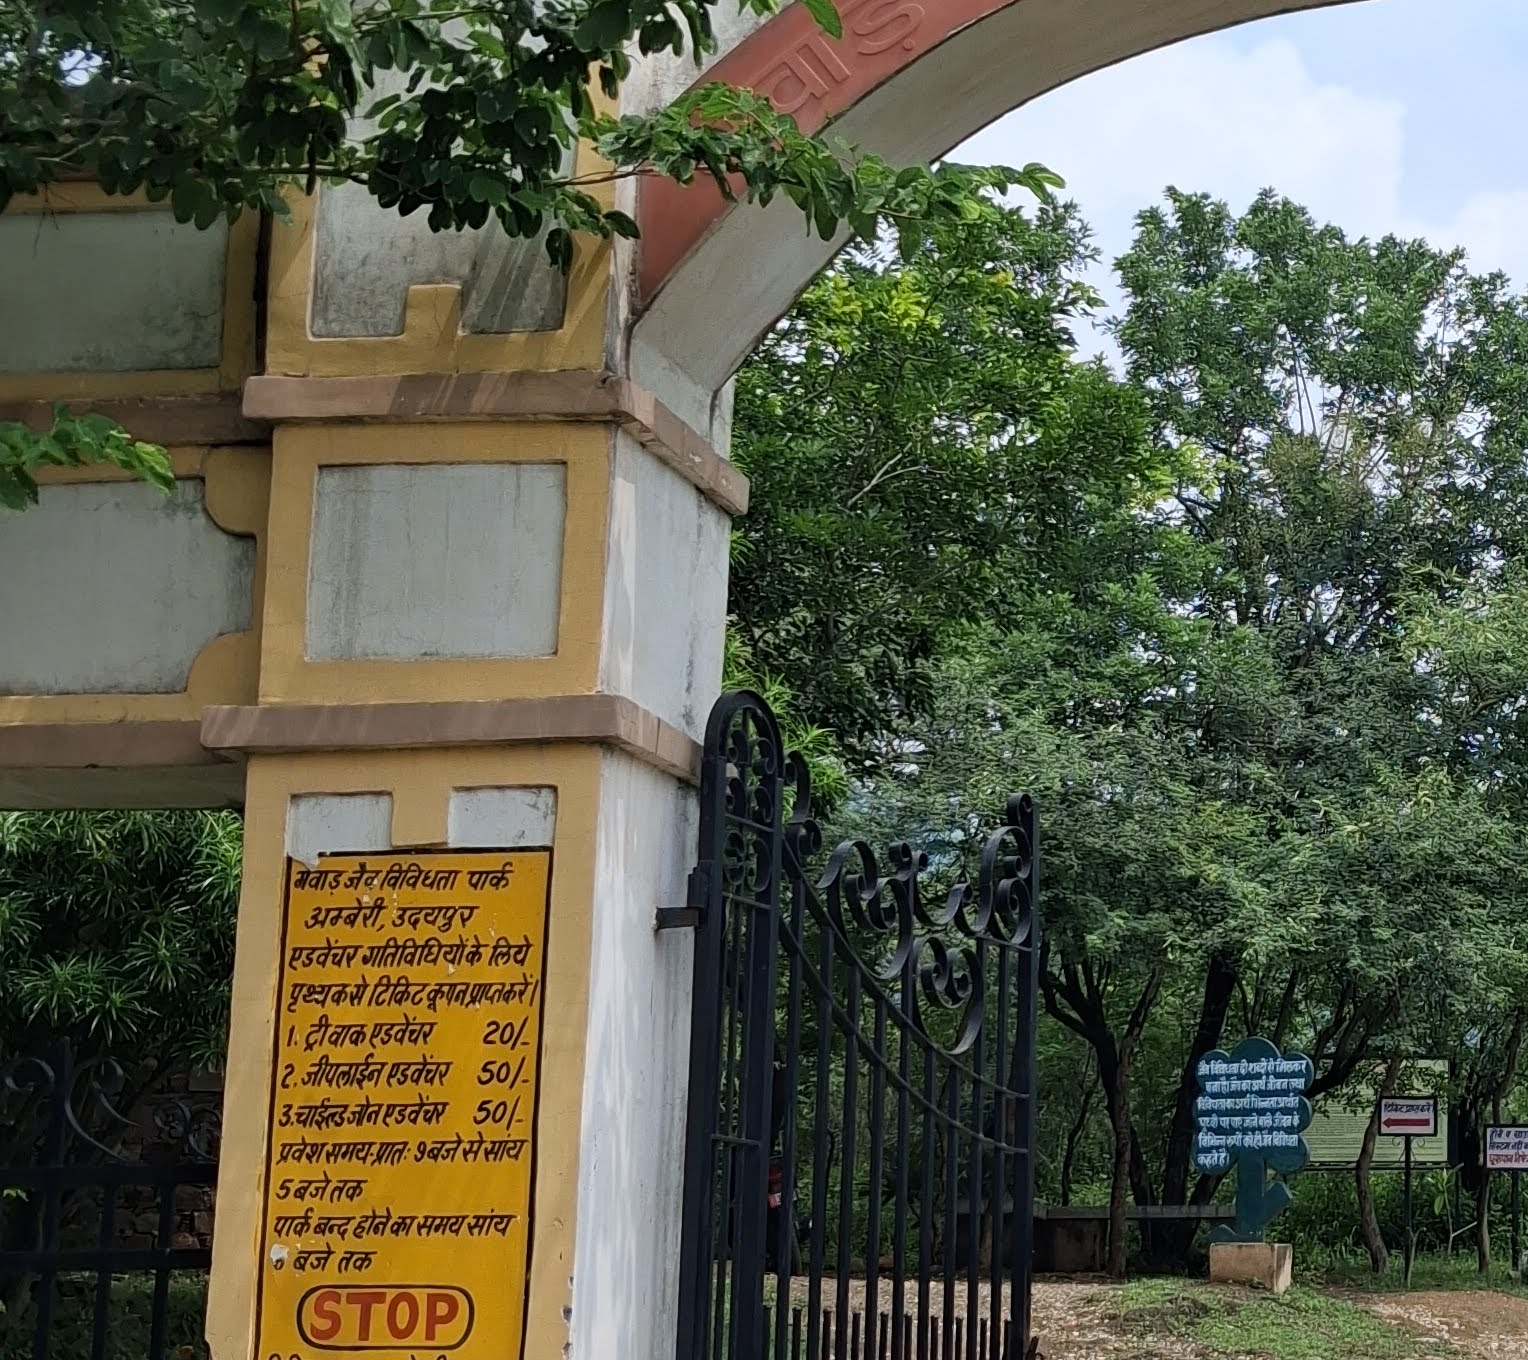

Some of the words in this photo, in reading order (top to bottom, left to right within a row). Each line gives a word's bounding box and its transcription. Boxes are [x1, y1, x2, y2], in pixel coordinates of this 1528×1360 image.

[380, 862, 461, 890] विविधता
[468, 862, 514, 890] पार्क
[392, 905, 480, 933] उदयपुर
[289, 937, 363, 970] एडवेंचर
[362, 934, 469, 967] गतिविधियों
[488, 934, 533, 966] लिये
[367, 975, 432, 1007] टिकिट
[304, 1014, 333, 1052] ट्री
[328, 1024, 367, 1048] वाक
[369, 1014, 438, 1049] एडवेंचर
[482, 1016, 530, 1050] 20/-
[301, 1053, 388, 1090] जीपलाईन
[387, 1054, 453, 1087] एडवेंचर
[477, 1057, 530, 1090] 50/-
[348, 1096, 384, 1126] जोन
[382, 1092, 449, 1127] एडवेंचर
[473, 1095, 524, 1131] 50/-
[276, 1136, 325, 1166] प्रवेश
[483, 1134, 530, 1163] सांय
[294, 1171, 331, 1202] बजे
[330, 1179, 368, 1203] तक
[274, 1207, 314, 1236] पार्क
[313, 1216, 355, 1240] बन्द
[353, 1207, 392, 1239] होने
[390, 1216, 418, 1237] का
[416, 1215, 469, 1236] समय
[467, 1209, 516, 1236] सांय
[293, 1242, 335, 1272] बजे
[338, 1250, 377, 1274] तक
[309, 1291, 459, 1341] STOP
